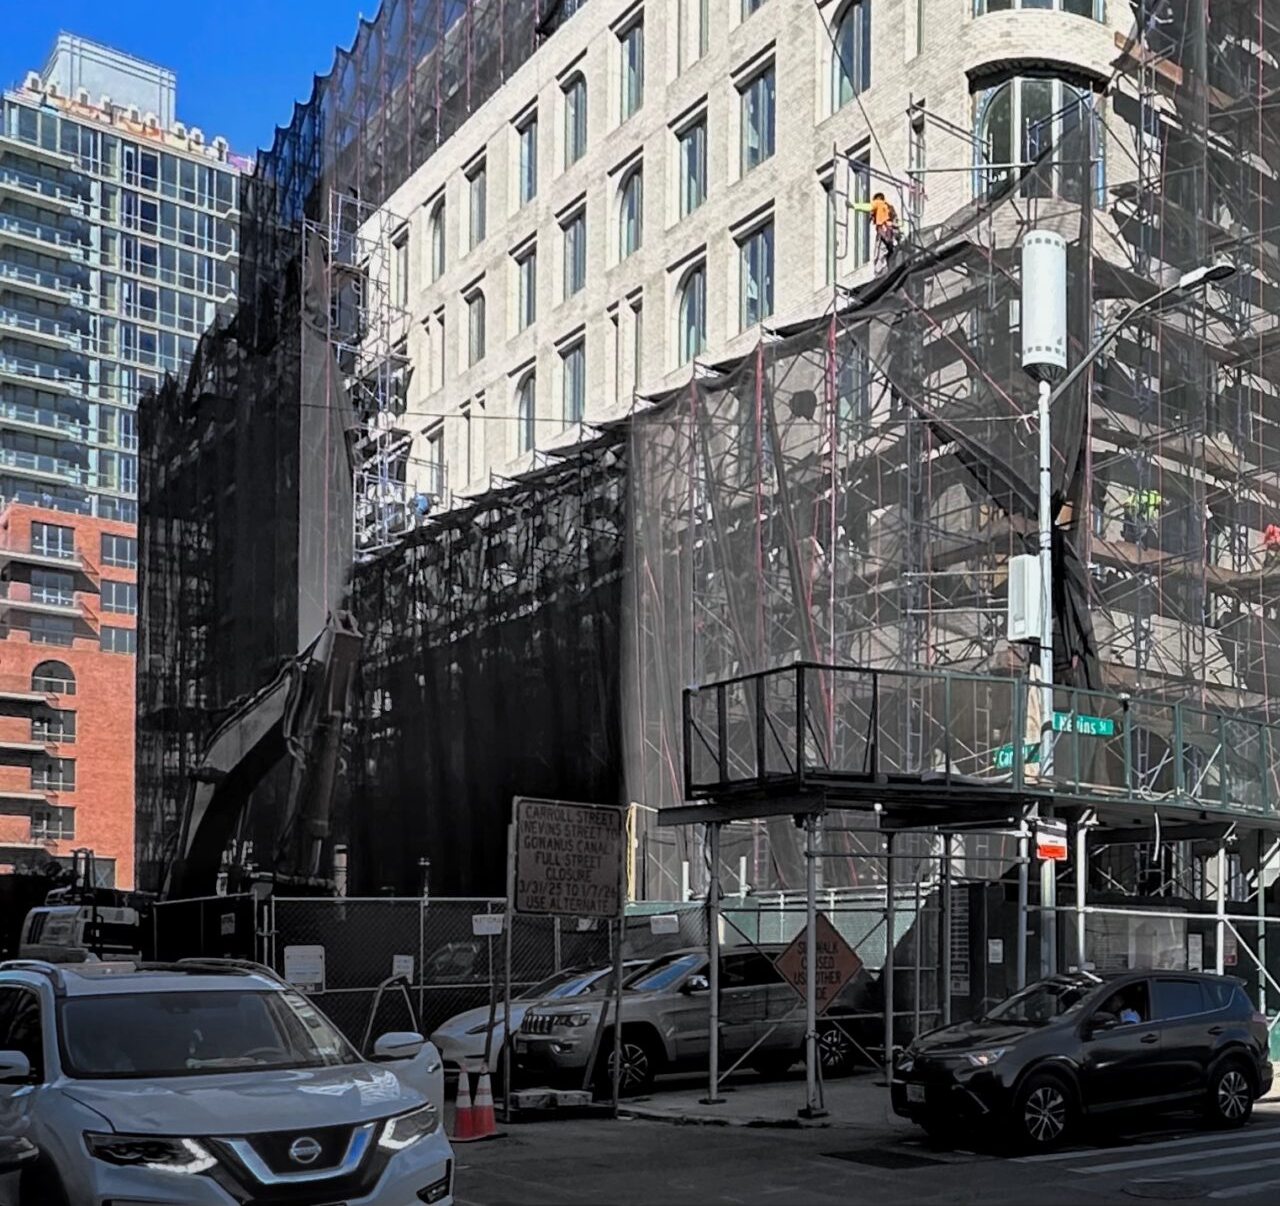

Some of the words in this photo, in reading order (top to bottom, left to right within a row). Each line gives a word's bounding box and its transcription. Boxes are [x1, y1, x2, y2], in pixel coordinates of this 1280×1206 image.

[525, 805, 574, 823] CARROLL
[576, 810, 614, 826] STREET
[564, 824, 601, 839] STREET
[524, 835, 574, 852] GOWANUS
[535, 851, 561, 867] FULL
[565, 854, 602, 869] STREET
[545, 867, 592, 882] CLOSURE
[566, 883, 579, 896] TO
[526, 896, 546, 909] USE
[550, 897, 609, 912] ALTERNATE
